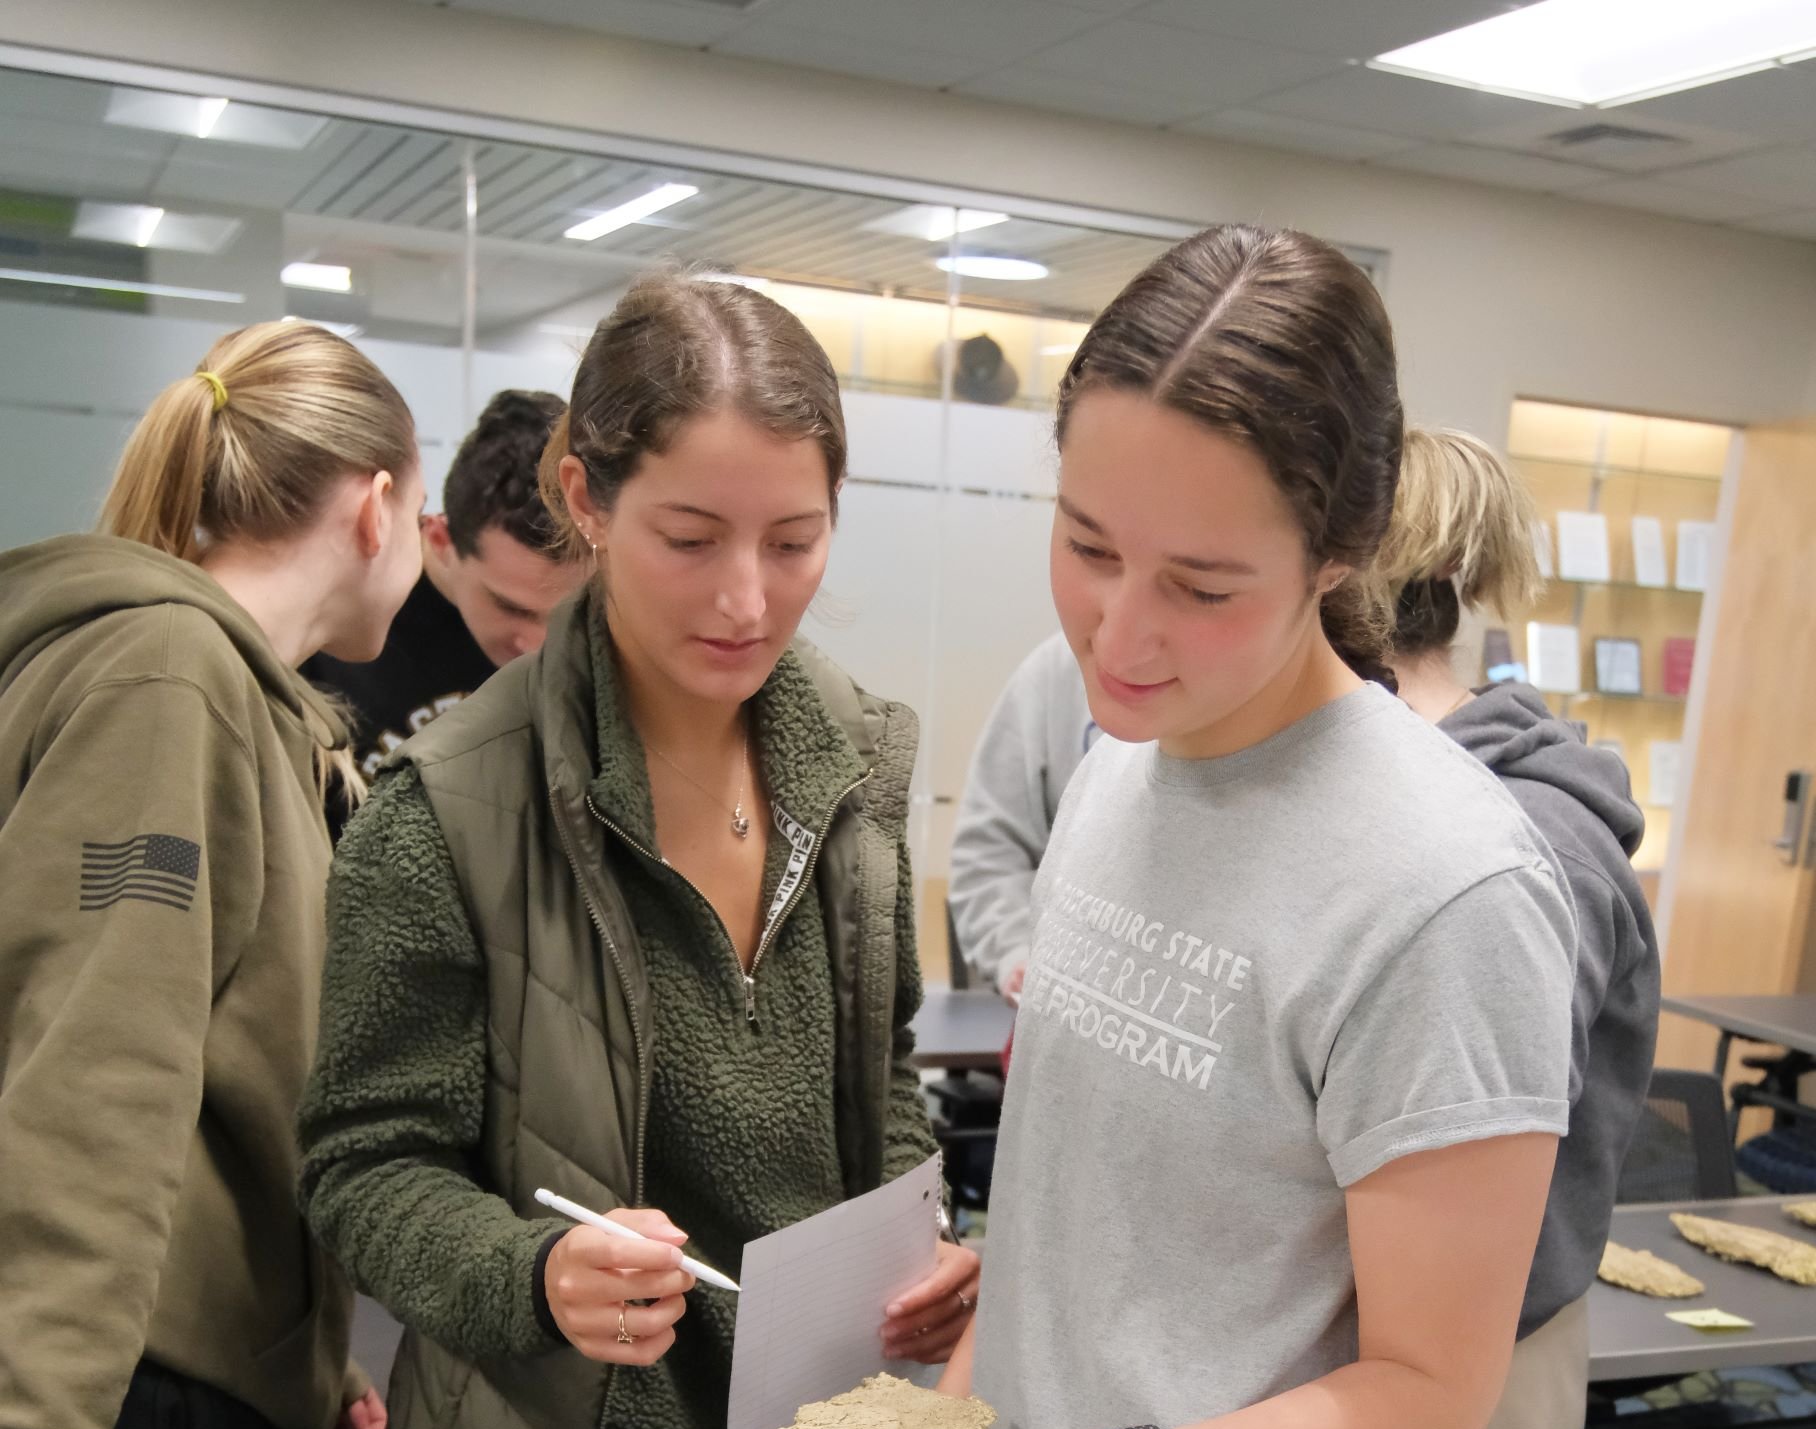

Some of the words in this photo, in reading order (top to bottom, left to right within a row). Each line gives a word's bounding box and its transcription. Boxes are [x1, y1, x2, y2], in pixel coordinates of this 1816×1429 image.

[776, 869, 799, 902] PINK
[1163, 931, 1252, 991] STATE
[1047, 985, 1217, 1090] PROGRAM
